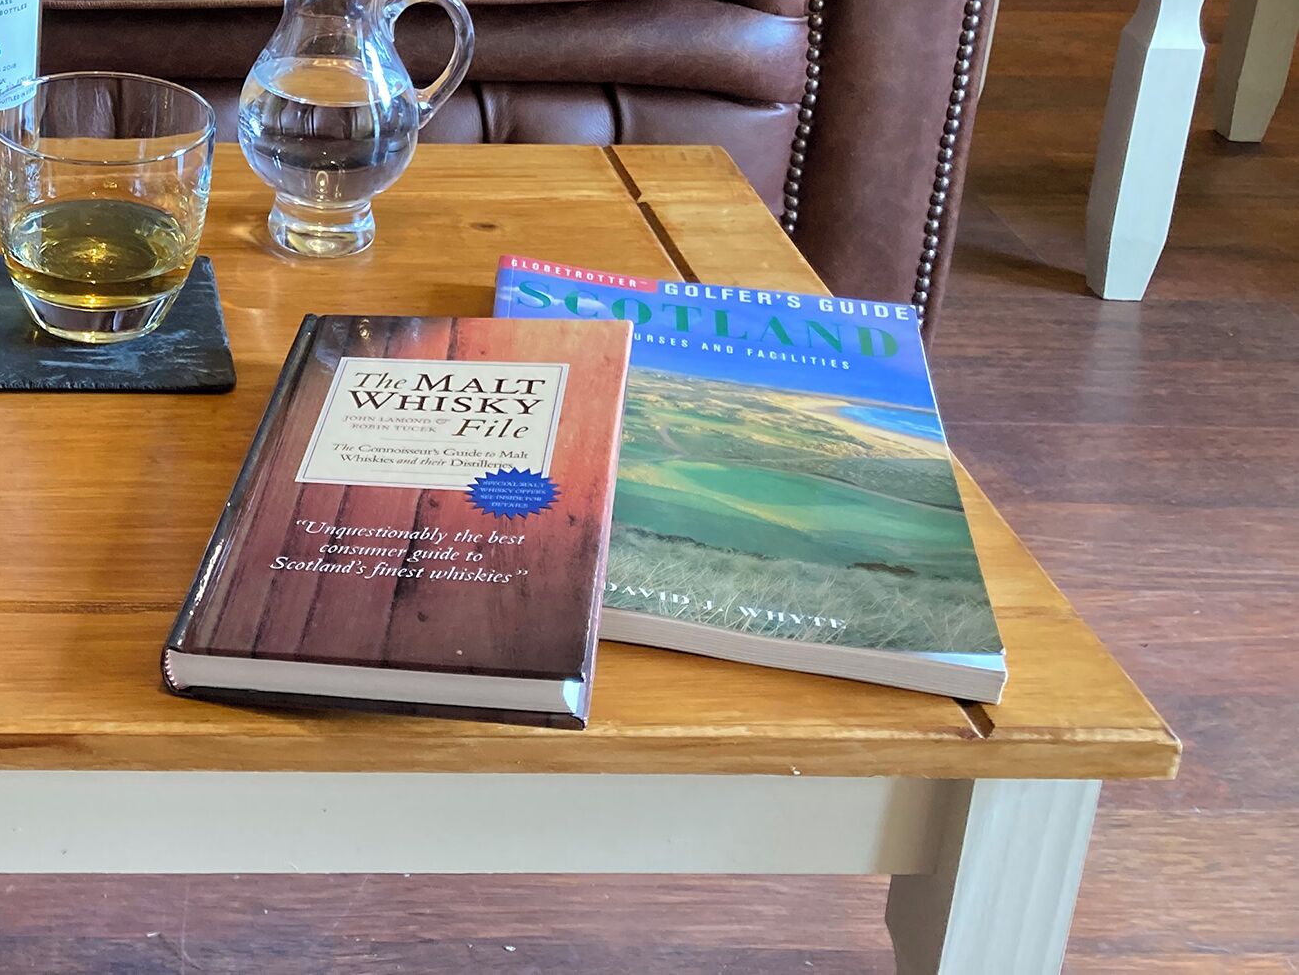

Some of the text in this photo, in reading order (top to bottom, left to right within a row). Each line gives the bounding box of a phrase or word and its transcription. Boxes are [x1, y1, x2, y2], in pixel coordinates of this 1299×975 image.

[664, 282, 910, 321] GOLFER'S GUIDE
[516, 280, 900, 359] SCOTLAND
[634, 333, 851, 370] URSES AND FACILITIES
[354, 372, 546, 396] The MALT
[348, 390, 544, 415] WHISKY
[351, 423, 437, 433] ROBIN TUCEK
[380, 416, 432, 424] LAMOND
[451, 418, 529, 439] File
[333, 442, 355, 452] The
[443, 448, 483, 458] Guide
[485, 449, 497, 459] to
[499, 449, 529, 460] Malt
[340, 453, 513, 470] Whiskies and their Distilleries
[453, 529, 484, 545] the
[488, 529, 526, 546] best
[318, 542, 484, 563] consumer guide to
[365, 560, 425, 580] finest
[603, 581, 691, 606] DAVID
[737, 605, 848, 630] WHYTE
